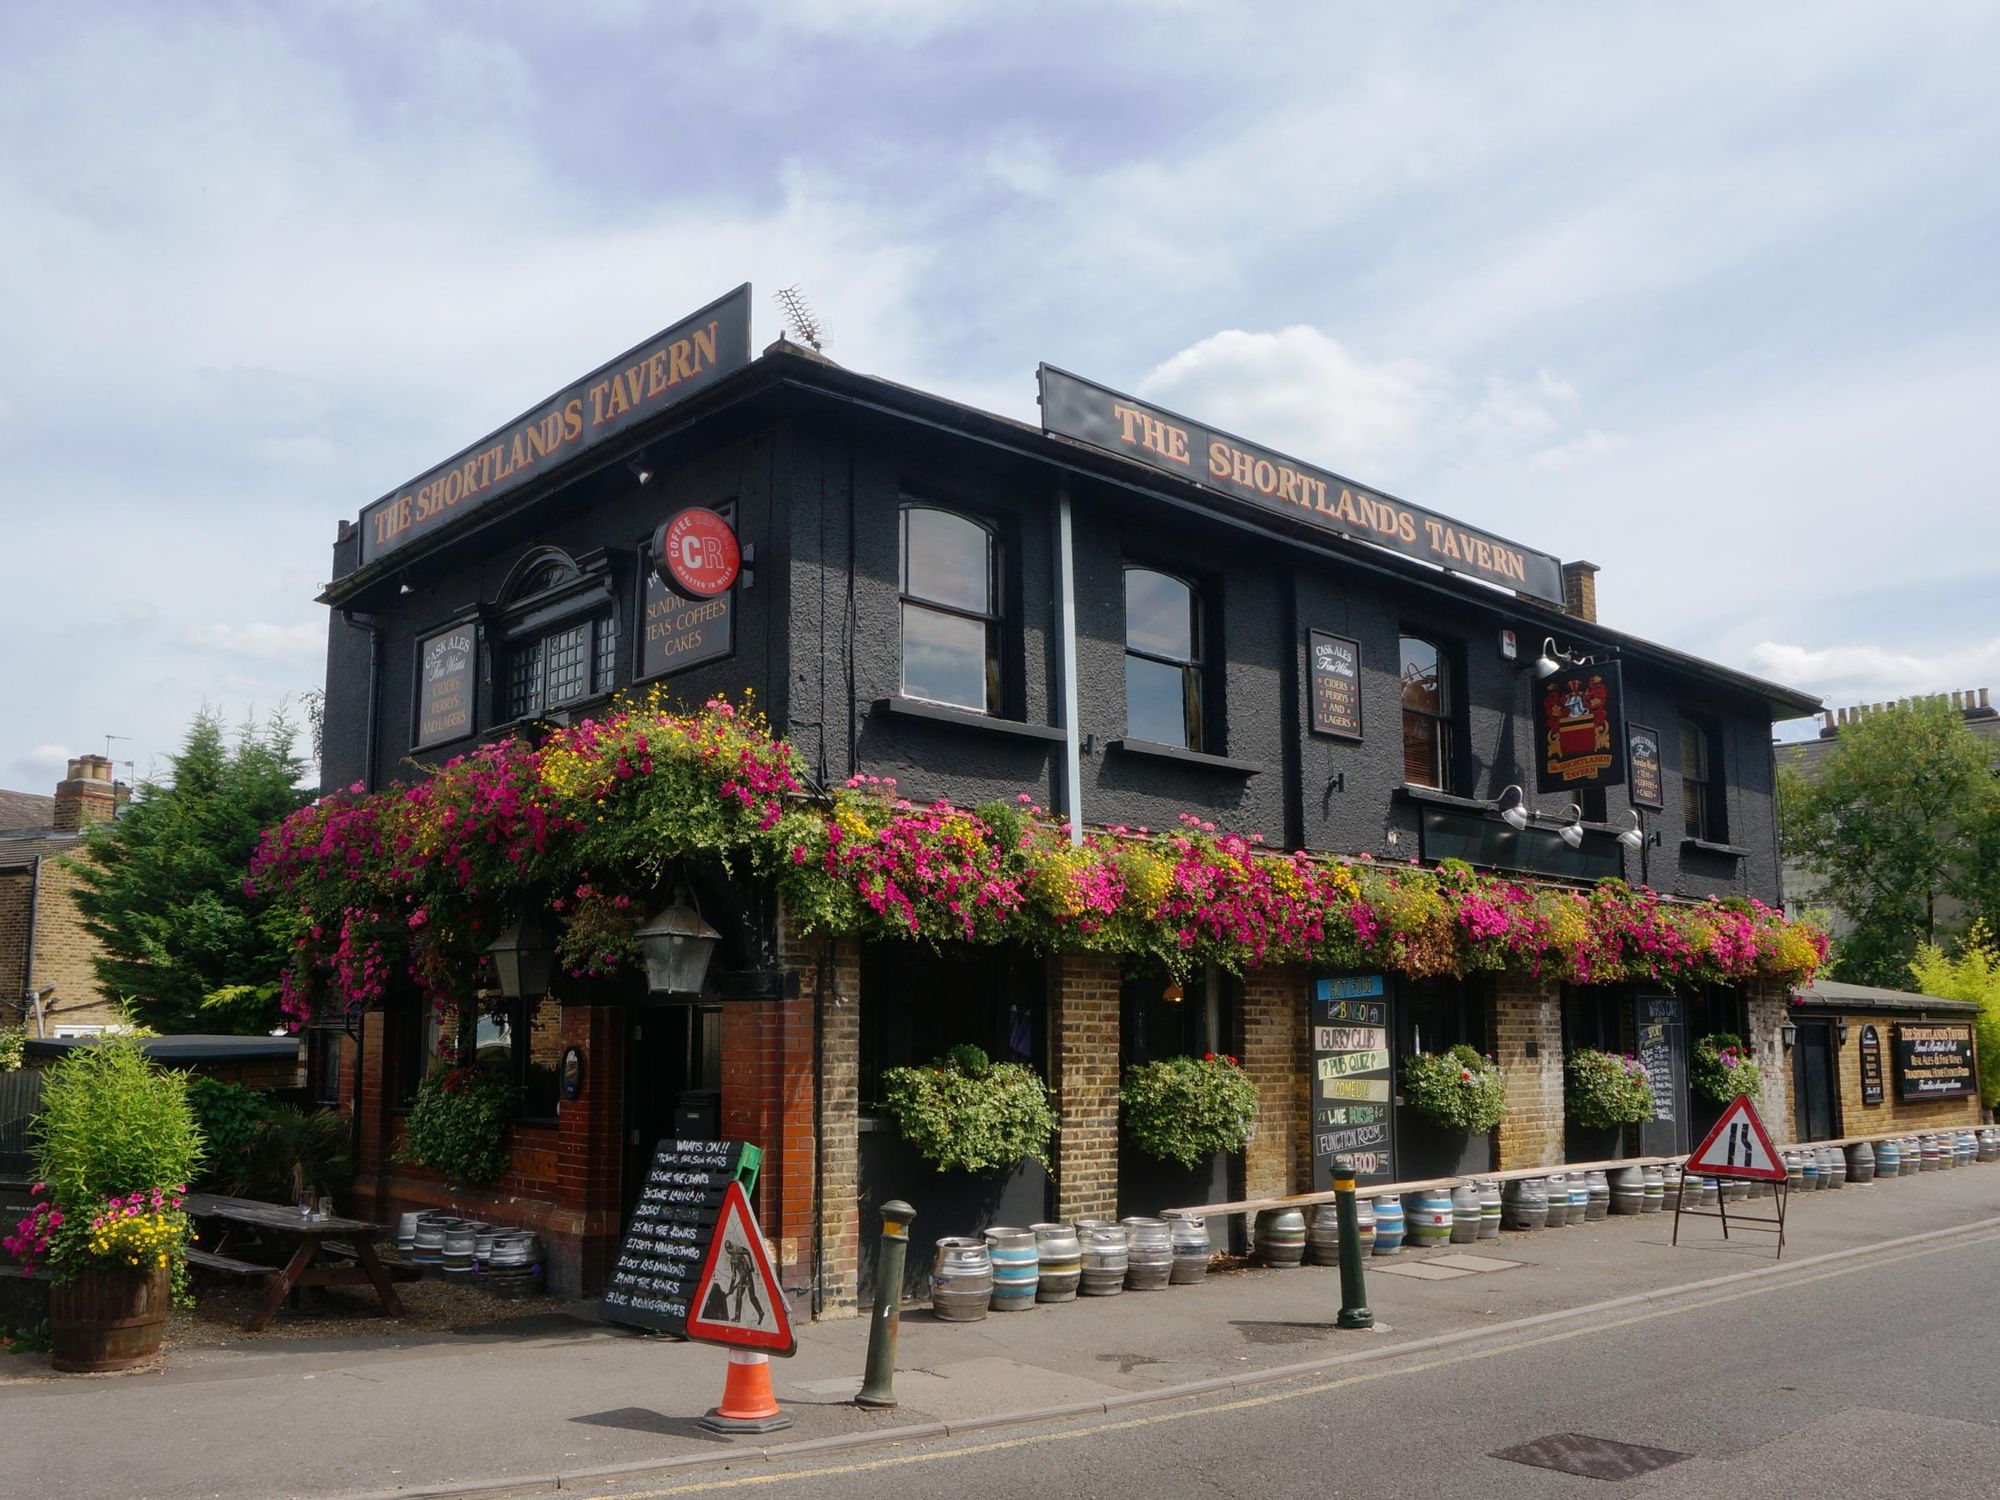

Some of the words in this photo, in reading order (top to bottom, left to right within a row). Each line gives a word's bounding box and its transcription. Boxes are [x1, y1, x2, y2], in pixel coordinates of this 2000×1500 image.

[375, 494, 413, 547] THE
[415, 398, 583, 524] SHORTLANDS
[590, 320, 720, 428] TAVERN
[1114, 403, 1191, 466] THE
[1208, 440, 1417, 544] SHORTLANDS
[1424, 519, 1526, 583] TAVERN
[670, 516, 693, 558] COFFEE
[682, 535, 724, 569] CR
[677, 565, 706, 590] ROASTED
[645, 618, 672, 642] TEAS
[676, 598, 727, 631] COFFEES
[425, 640, 448, 670] CASK
[447, 635, 471, 653] ALES
[664, 629, 702, 657] CAKES
[1316, 645, 1334, 657] CASK
[1335, 646, 1352, 663] ALES
[1317, 657, 1336, 672] Fine
[1324, 678, 1348, 691] CIDERS
[1326, 690, 1349, 703] PERRYS
[1329, 703, 1345, 714] AND
[1324, 714, 1351, 728] LAGERS
[1559, 755, 1611, 770] SHORTLANDS
[1566, 766, 1596, 779] TAVERN
[1321, 1028, 1350, 1050] CURRY
[1351, 1028, 1376, 1050] CLUB
[1901, 1028, 1913, 1041] THE
[1328, 1056, 1347, 1076] PUB
[1349, 1053, 1370, 1072] QUIZ
[1327, 1107, 1348, 1125] LIVE
[1320, 1129, 1357, 1153] FUNCTION
[1358, 1124, 1381, 1145] ROOM
[636, 1276, 652, 1290] THE
